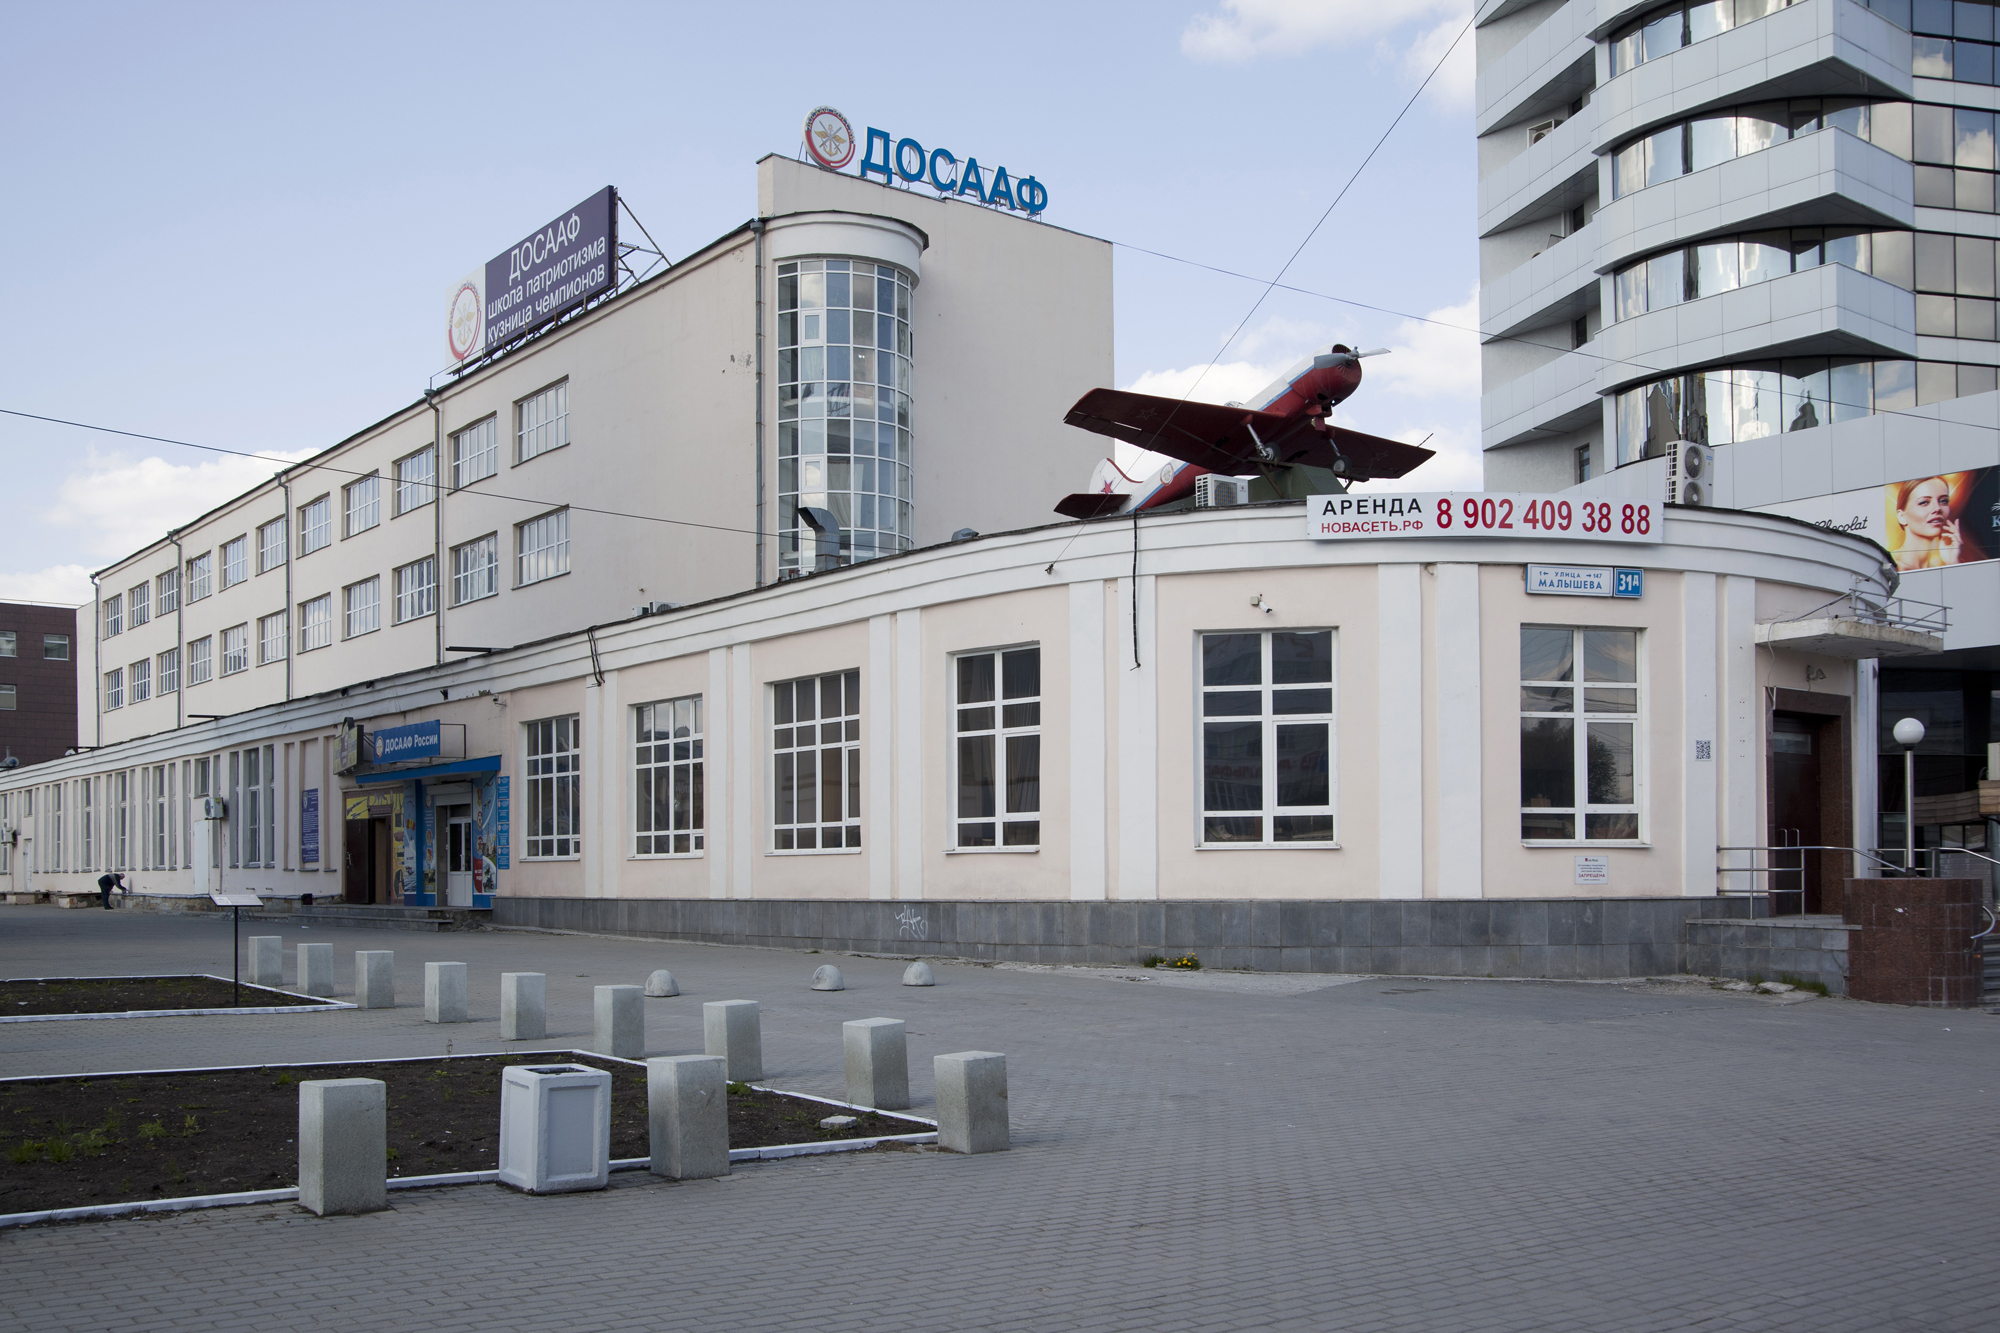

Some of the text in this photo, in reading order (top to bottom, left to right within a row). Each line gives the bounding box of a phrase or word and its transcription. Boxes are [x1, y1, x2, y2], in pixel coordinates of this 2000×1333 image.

[858, 126, 1048, 215] ДОСААФ
[509, 213, 580, 286] ДОСААФ
[488, 285, 523, 320] школа
[526, 236, 606, 298] патриотизма
[487, 304, 533, 346] кузница
[535, 263, 605, 316] чемпионов
[1322, 498, 1422, 517] АРЕНДА
[1436, 498, 1651, 535] 8 902 409 38 88
[1321, 520, 1424, 534] НОВАСЕТЬ.РФ
[1538, 578, 1602, 590] МАЛЫШЕВА
[1554, 571, 1581, 579] УЛИЦА
[384, 734, 438, 755] ДОСААФ России
